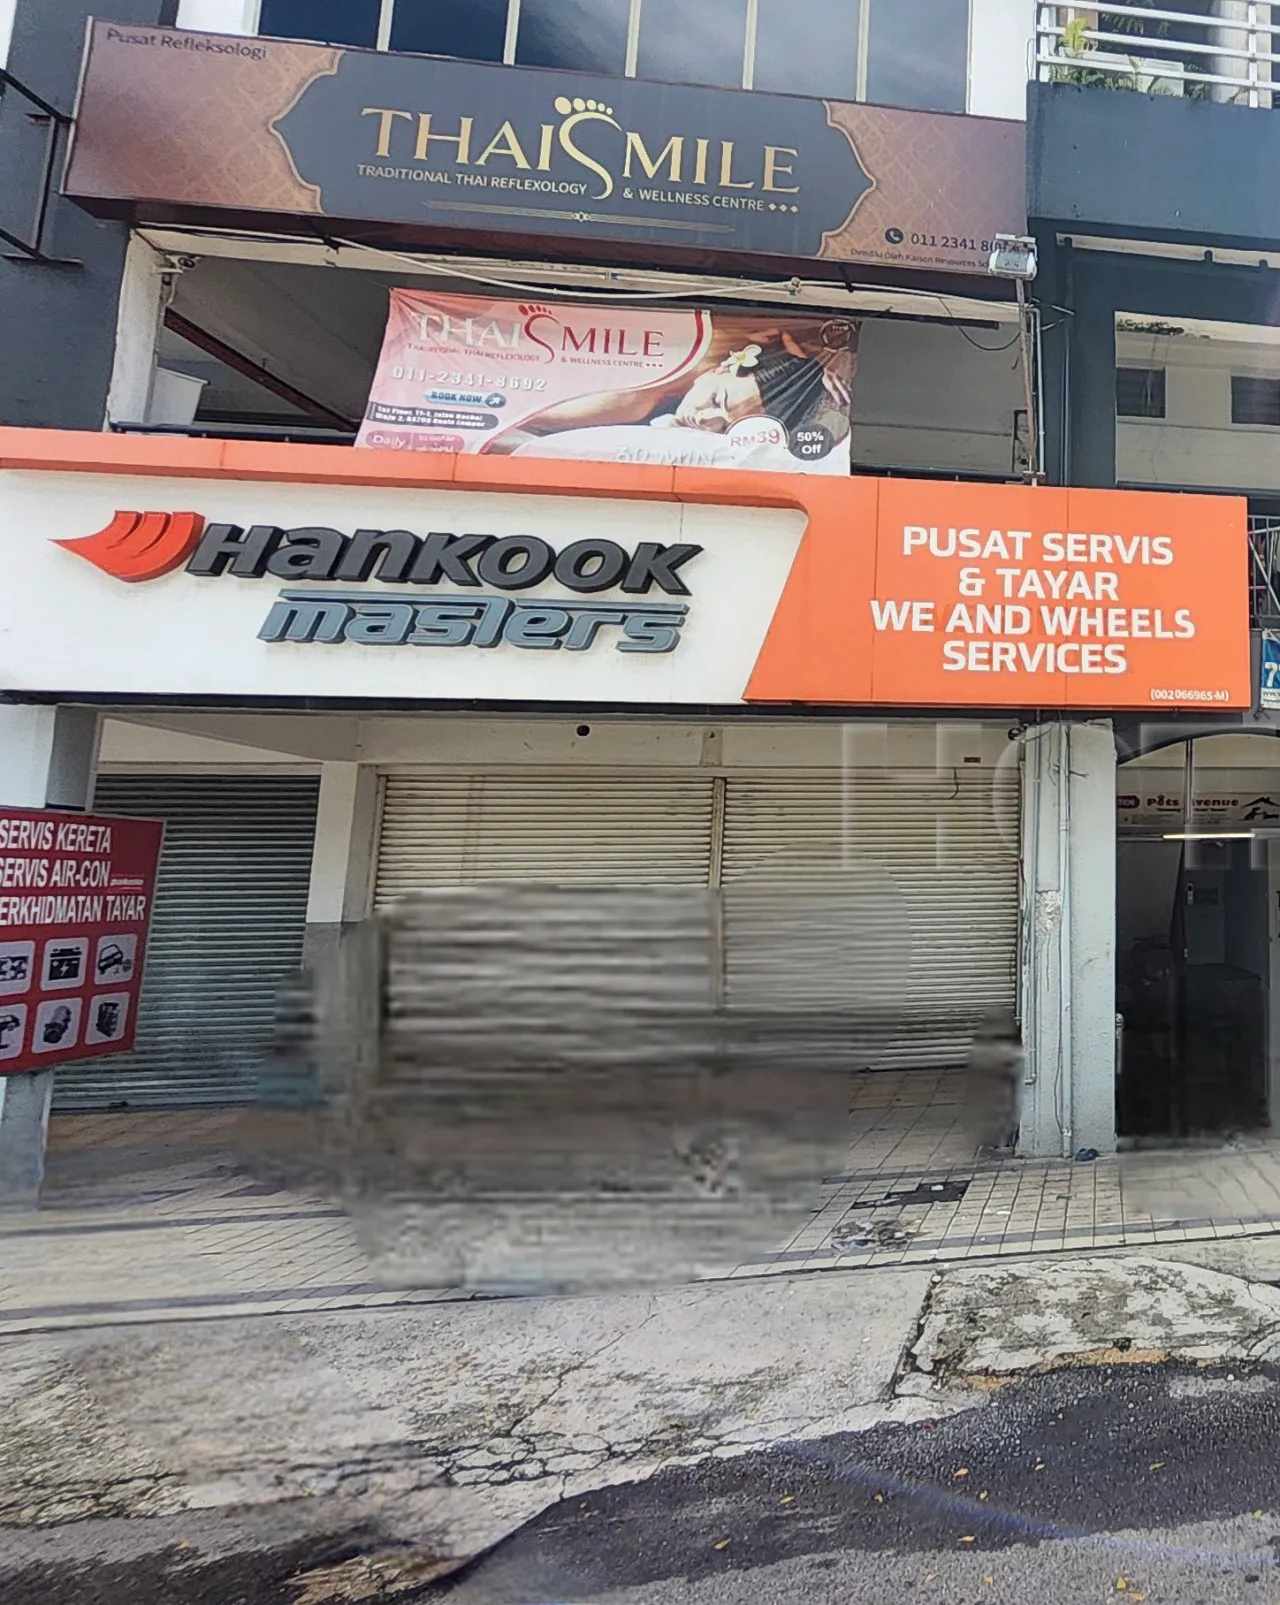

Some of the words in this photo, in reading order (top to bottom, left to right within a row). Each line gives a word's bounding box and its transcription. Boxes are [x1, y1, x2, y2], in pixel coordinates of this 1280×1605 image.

[107, 28, 156, 46] Pusat
[160, 36, 267, 60] Refleksologi
[357, 164, 452, 184] TRADITIONAL
[456, 173, 487, 187] THAI
[492, 176, 588, 195] REFLEXOLOGY
[623, 187, 634, 199] &
[639, 189, 710, 206] WELLNESS
[712, 196, 764, 211] CENTRE
[911, 233, 936, 246] 011
[941, 236, 976, 250] 2341
[430, 390, 458, 401] BOOK
[459, 392, 482, 403] NOW
[372, 434, 406, 448] Daily
[796, 431, 824, 442] 50%
[801, 444, 822, 454] Off
[902, 525, 1032, 560] PUSAT
[1042, 532, 1174, 566] SERVIS
[958, 568, 985, 597] &
[996, 568, 1120, 602] TAYAR
[870, 600, 935, 633] WE
[944, 601, 1035, 635] AND
[1042, 606, 1196, 640] WHEELS
[942, 640, 1128, 675] SERVICES
[0, 818, 55, 850] SERVIS
[56, 823, 112, 853] KERETA
[49, 859, 111, 888] AIR-CON
[106, 895, 147, 922] TAYAR
